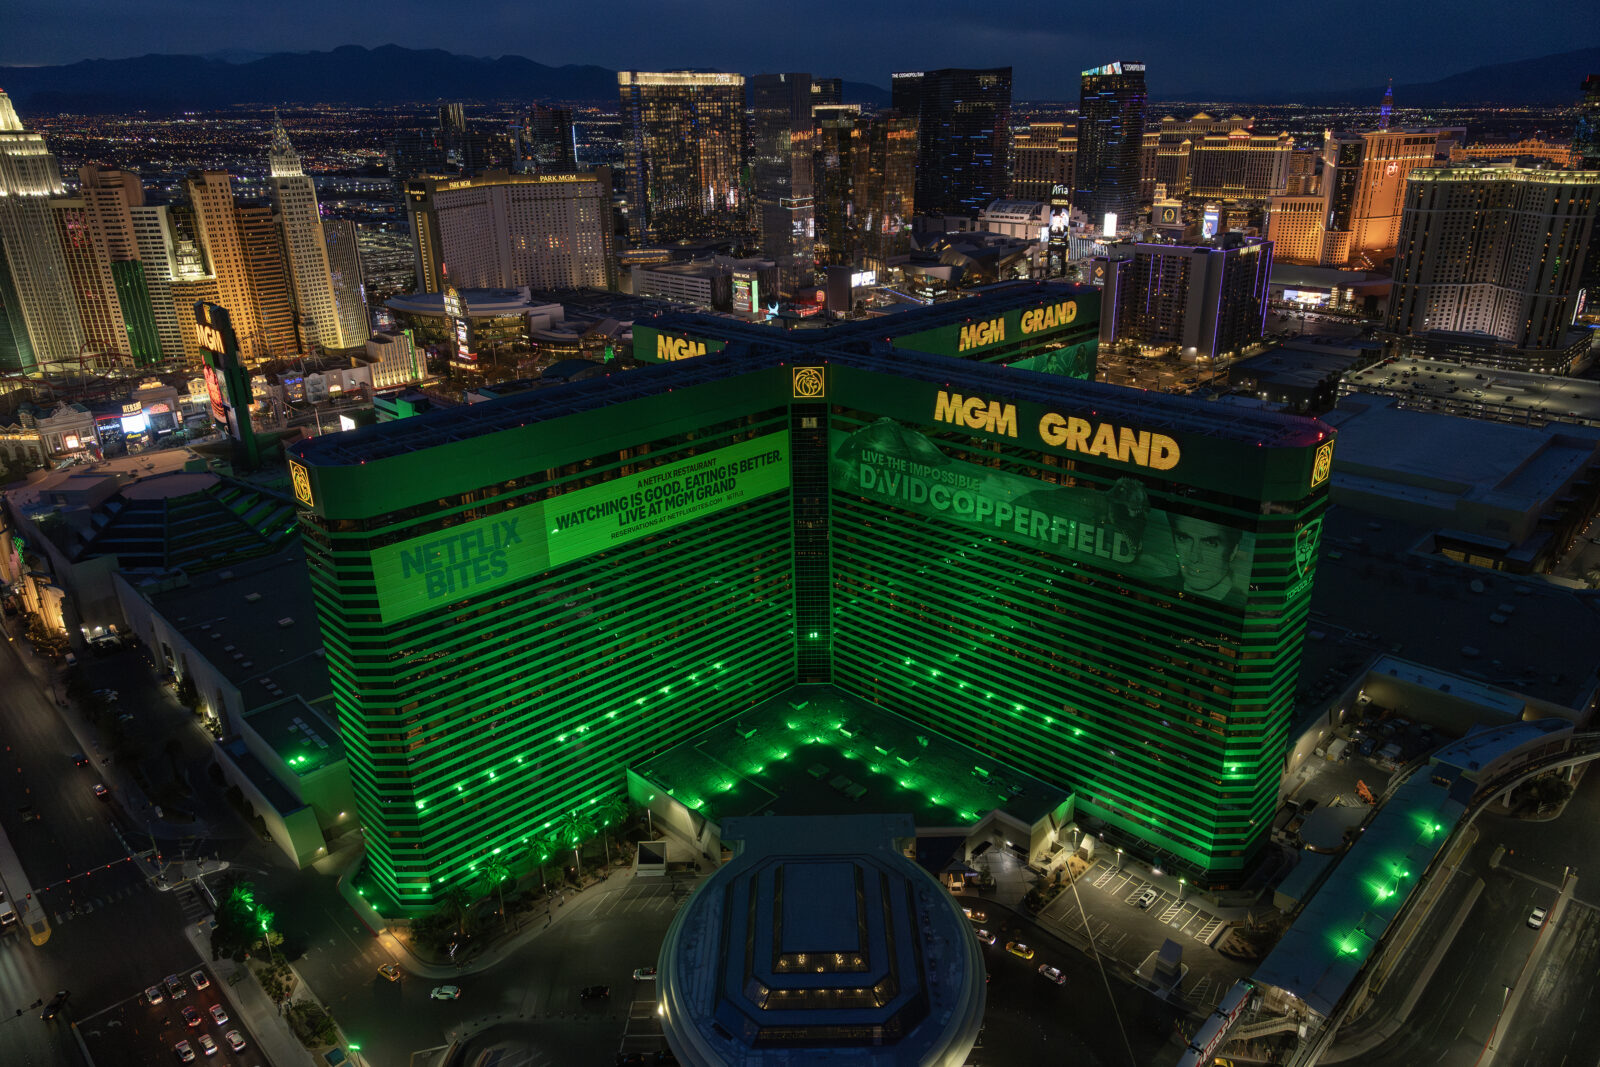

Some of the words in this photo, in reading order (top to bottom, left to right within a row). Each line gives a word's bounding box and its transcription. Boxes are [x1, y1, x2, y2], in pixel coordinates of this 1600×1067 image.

[1052, 184, 1069, 195] Aria
[196, 323, 226, 354] MGM
[657, 334, 707, 362] MGM
[959, 317, 1006, 352] MGM
[1020, 300, 1078, 335] GRAND
[933, 390, 1018, 438] MGM
[1038, 412, 1181, 471] GRAND
[555, 496, 629, 531] WATCHING
[630, 491, 643, 508] IS
[644, 481, 684, 504] GOOD.
[685, 467, 727, 490] EATING
[727, 462, 739, 478] IS
[740, 450, 783, 473] BETTER.
[643, 470, 673, 487] NETFLIX
[673, 458, 717, 477] RESTAURANT
[862, 449, 885, 466] LIVE
[887, 456, 907, 472] THE
[910, 462, 980, 490] IMPOSSIBLE
[618, 505, 647, 527] LIVE
[648, 500, 663, 518] AT
[665, 490, 695, 511] MGM
[696, 477, 736, 501] GRAND
[401, 517, 523, 579] NETFLIX
[611, 519, 658, 540] RESERVATIONS
[425, 550, 509, 600] BITES
